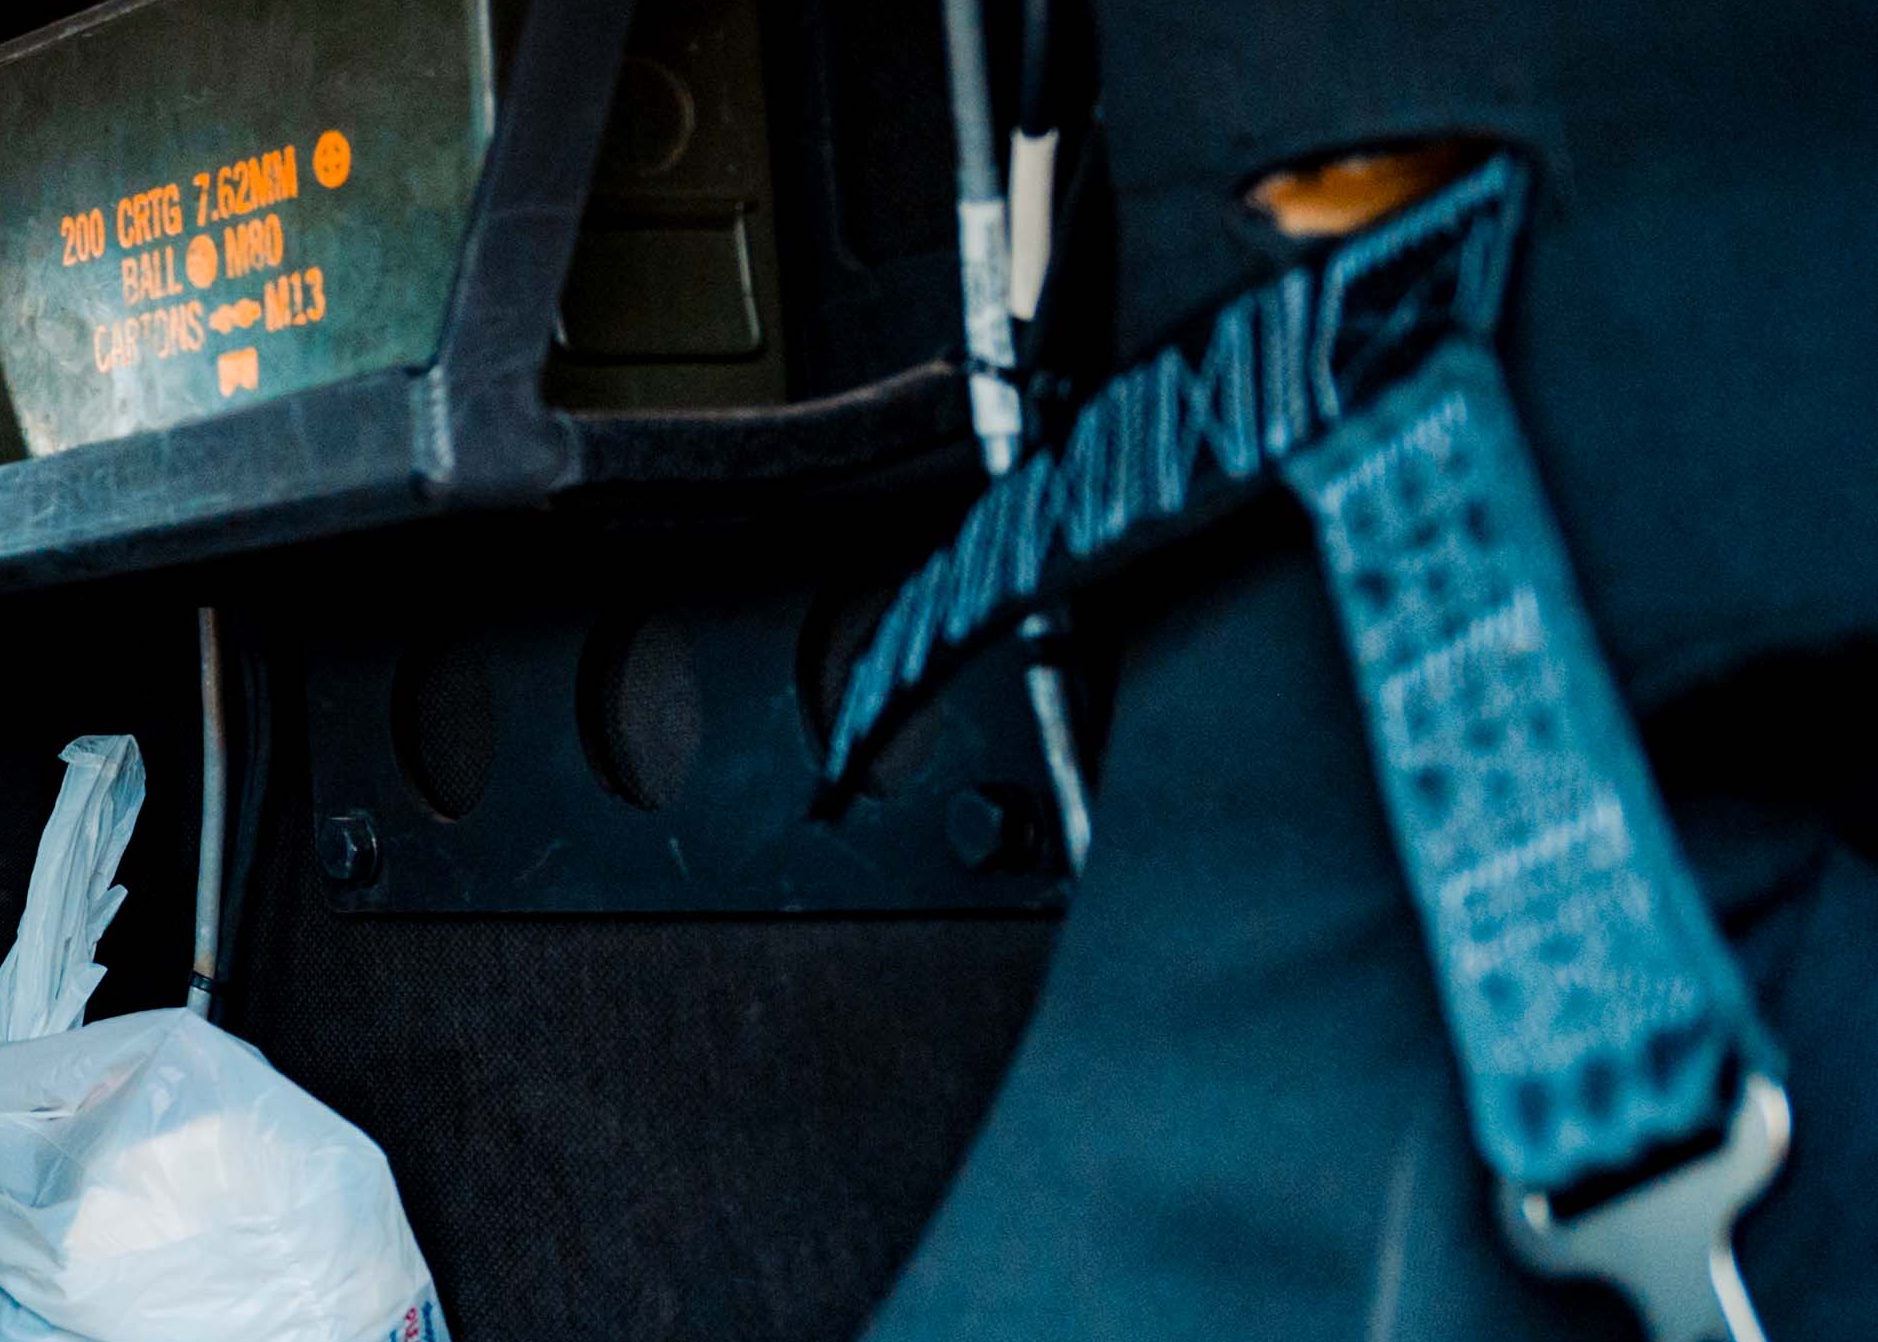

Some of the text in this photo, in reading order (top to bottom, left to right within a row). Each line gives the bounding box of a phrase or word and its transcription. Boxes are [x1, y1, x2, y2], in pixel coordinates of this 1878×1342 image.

[61, 145, 298, 267] 200 CRTG 7.62MM
[121, 213, 284, 307] BALL M80
[93, 266, 326, 374] CARTONS M13
